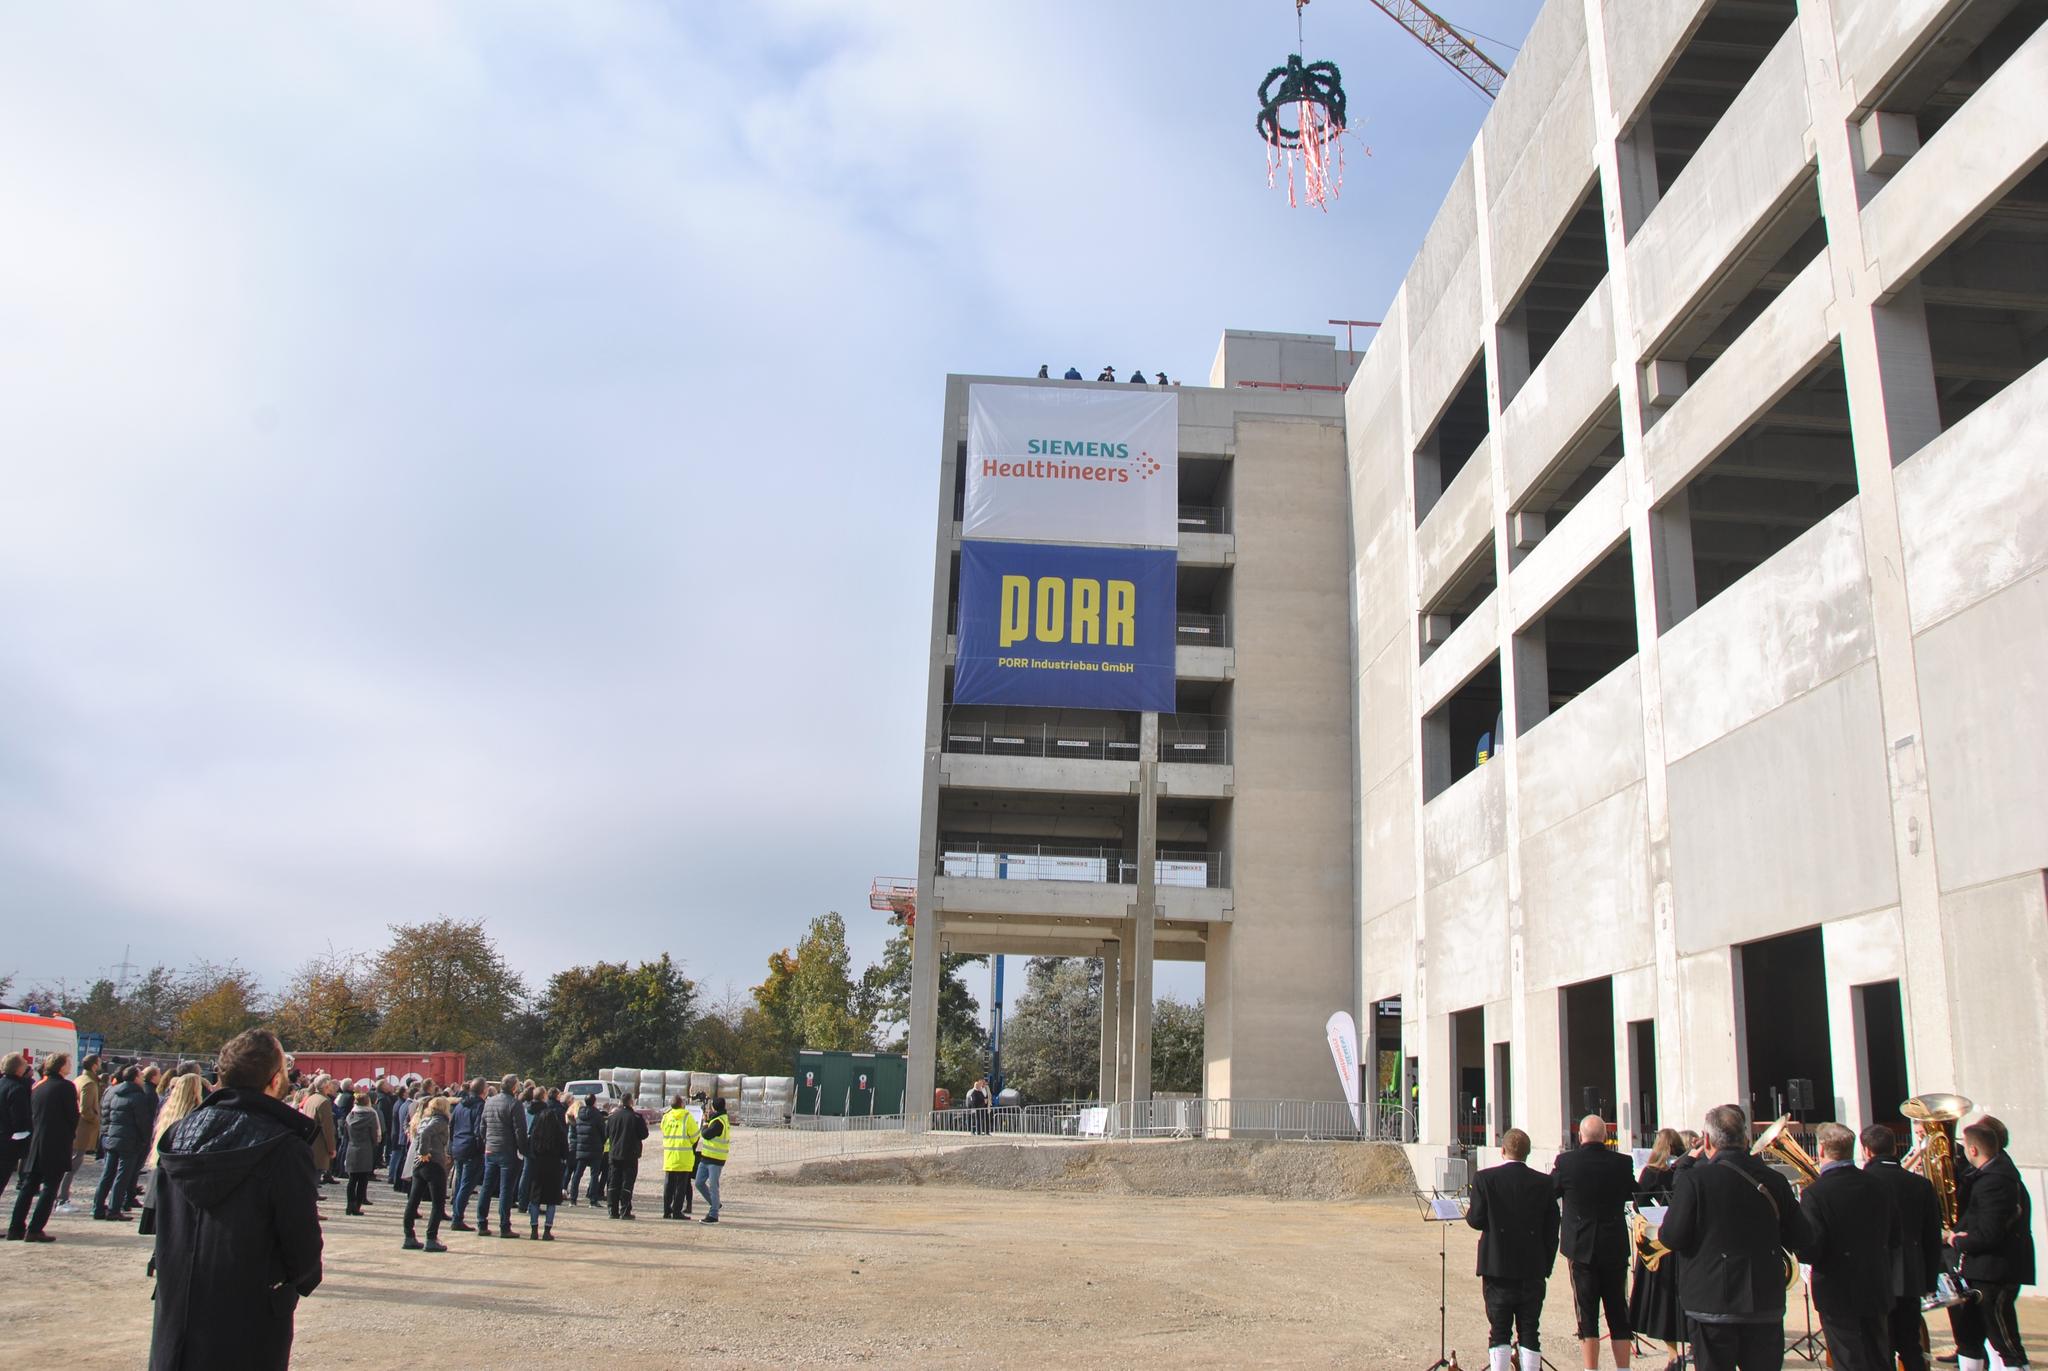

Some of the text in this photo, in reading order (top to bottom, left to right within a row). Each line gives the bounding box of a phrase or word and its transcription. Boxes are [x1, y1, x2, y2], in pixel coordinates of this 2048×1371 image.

[1028, 439, 1129, 459] SIEMENS
[983, 459, 1129, 483] Healthineers
[1000, 575, 1136, 648] PORR
[998, 657, 1135, 673] PORR Industriebau GmbH
